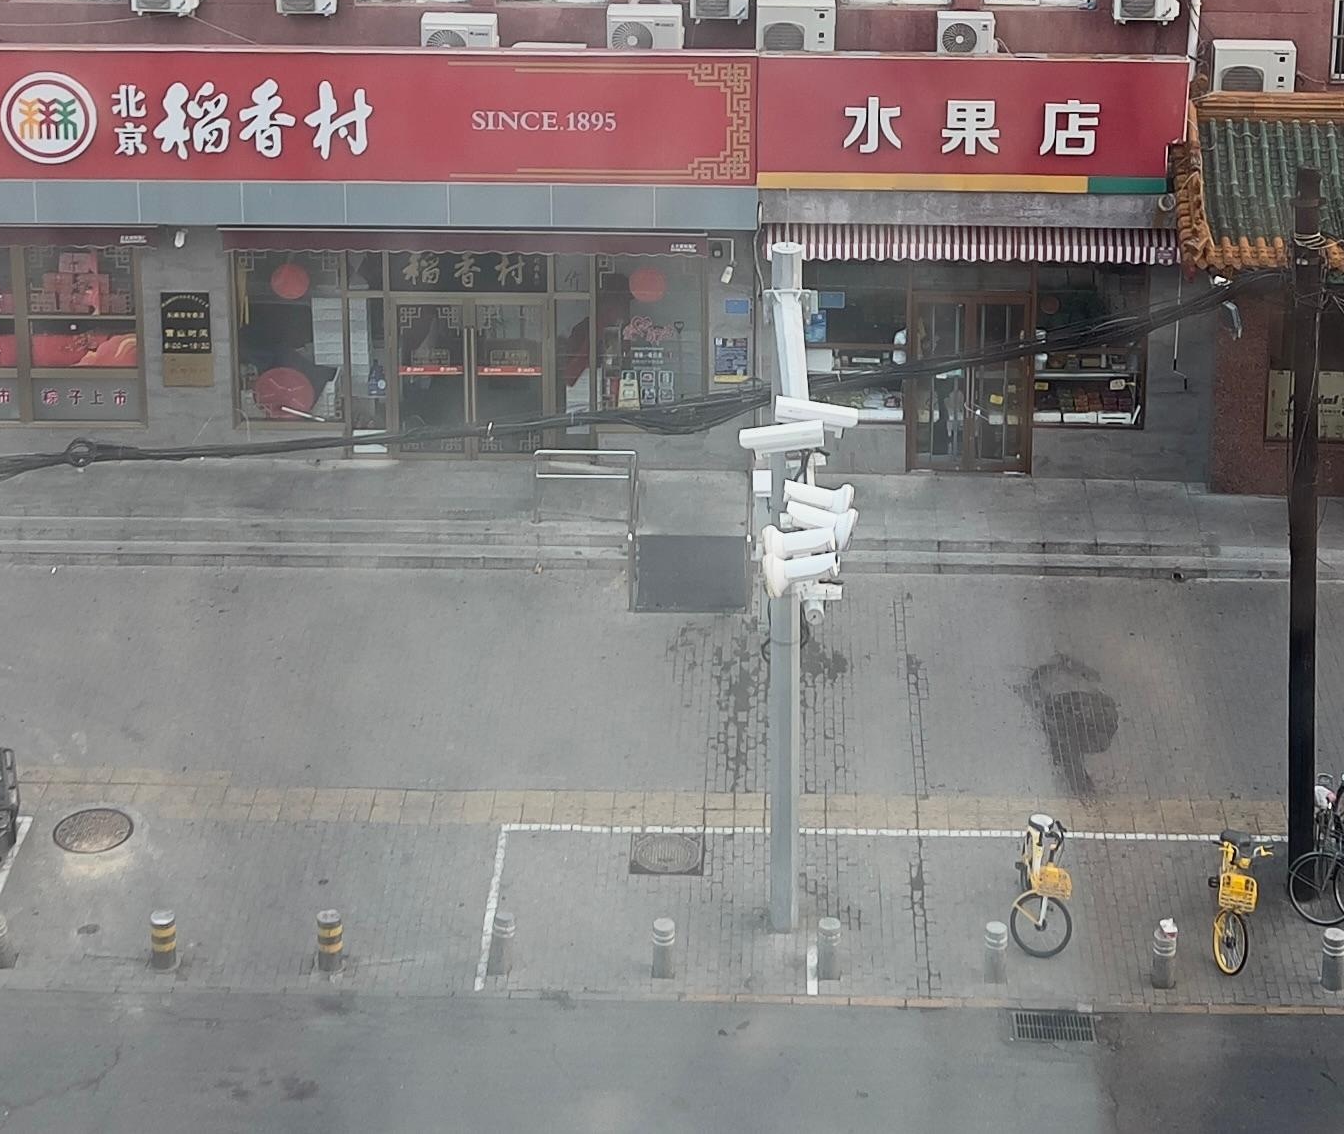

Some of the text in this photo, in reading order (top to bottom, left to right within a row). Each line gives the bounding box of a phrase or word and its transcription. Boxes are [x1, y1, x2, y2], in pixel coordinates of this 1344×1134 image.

[111, 84, 147, 156] 北京
[153, 78, 373, 160] 稻香村
[843, 96, 1101, 156] 水果店
